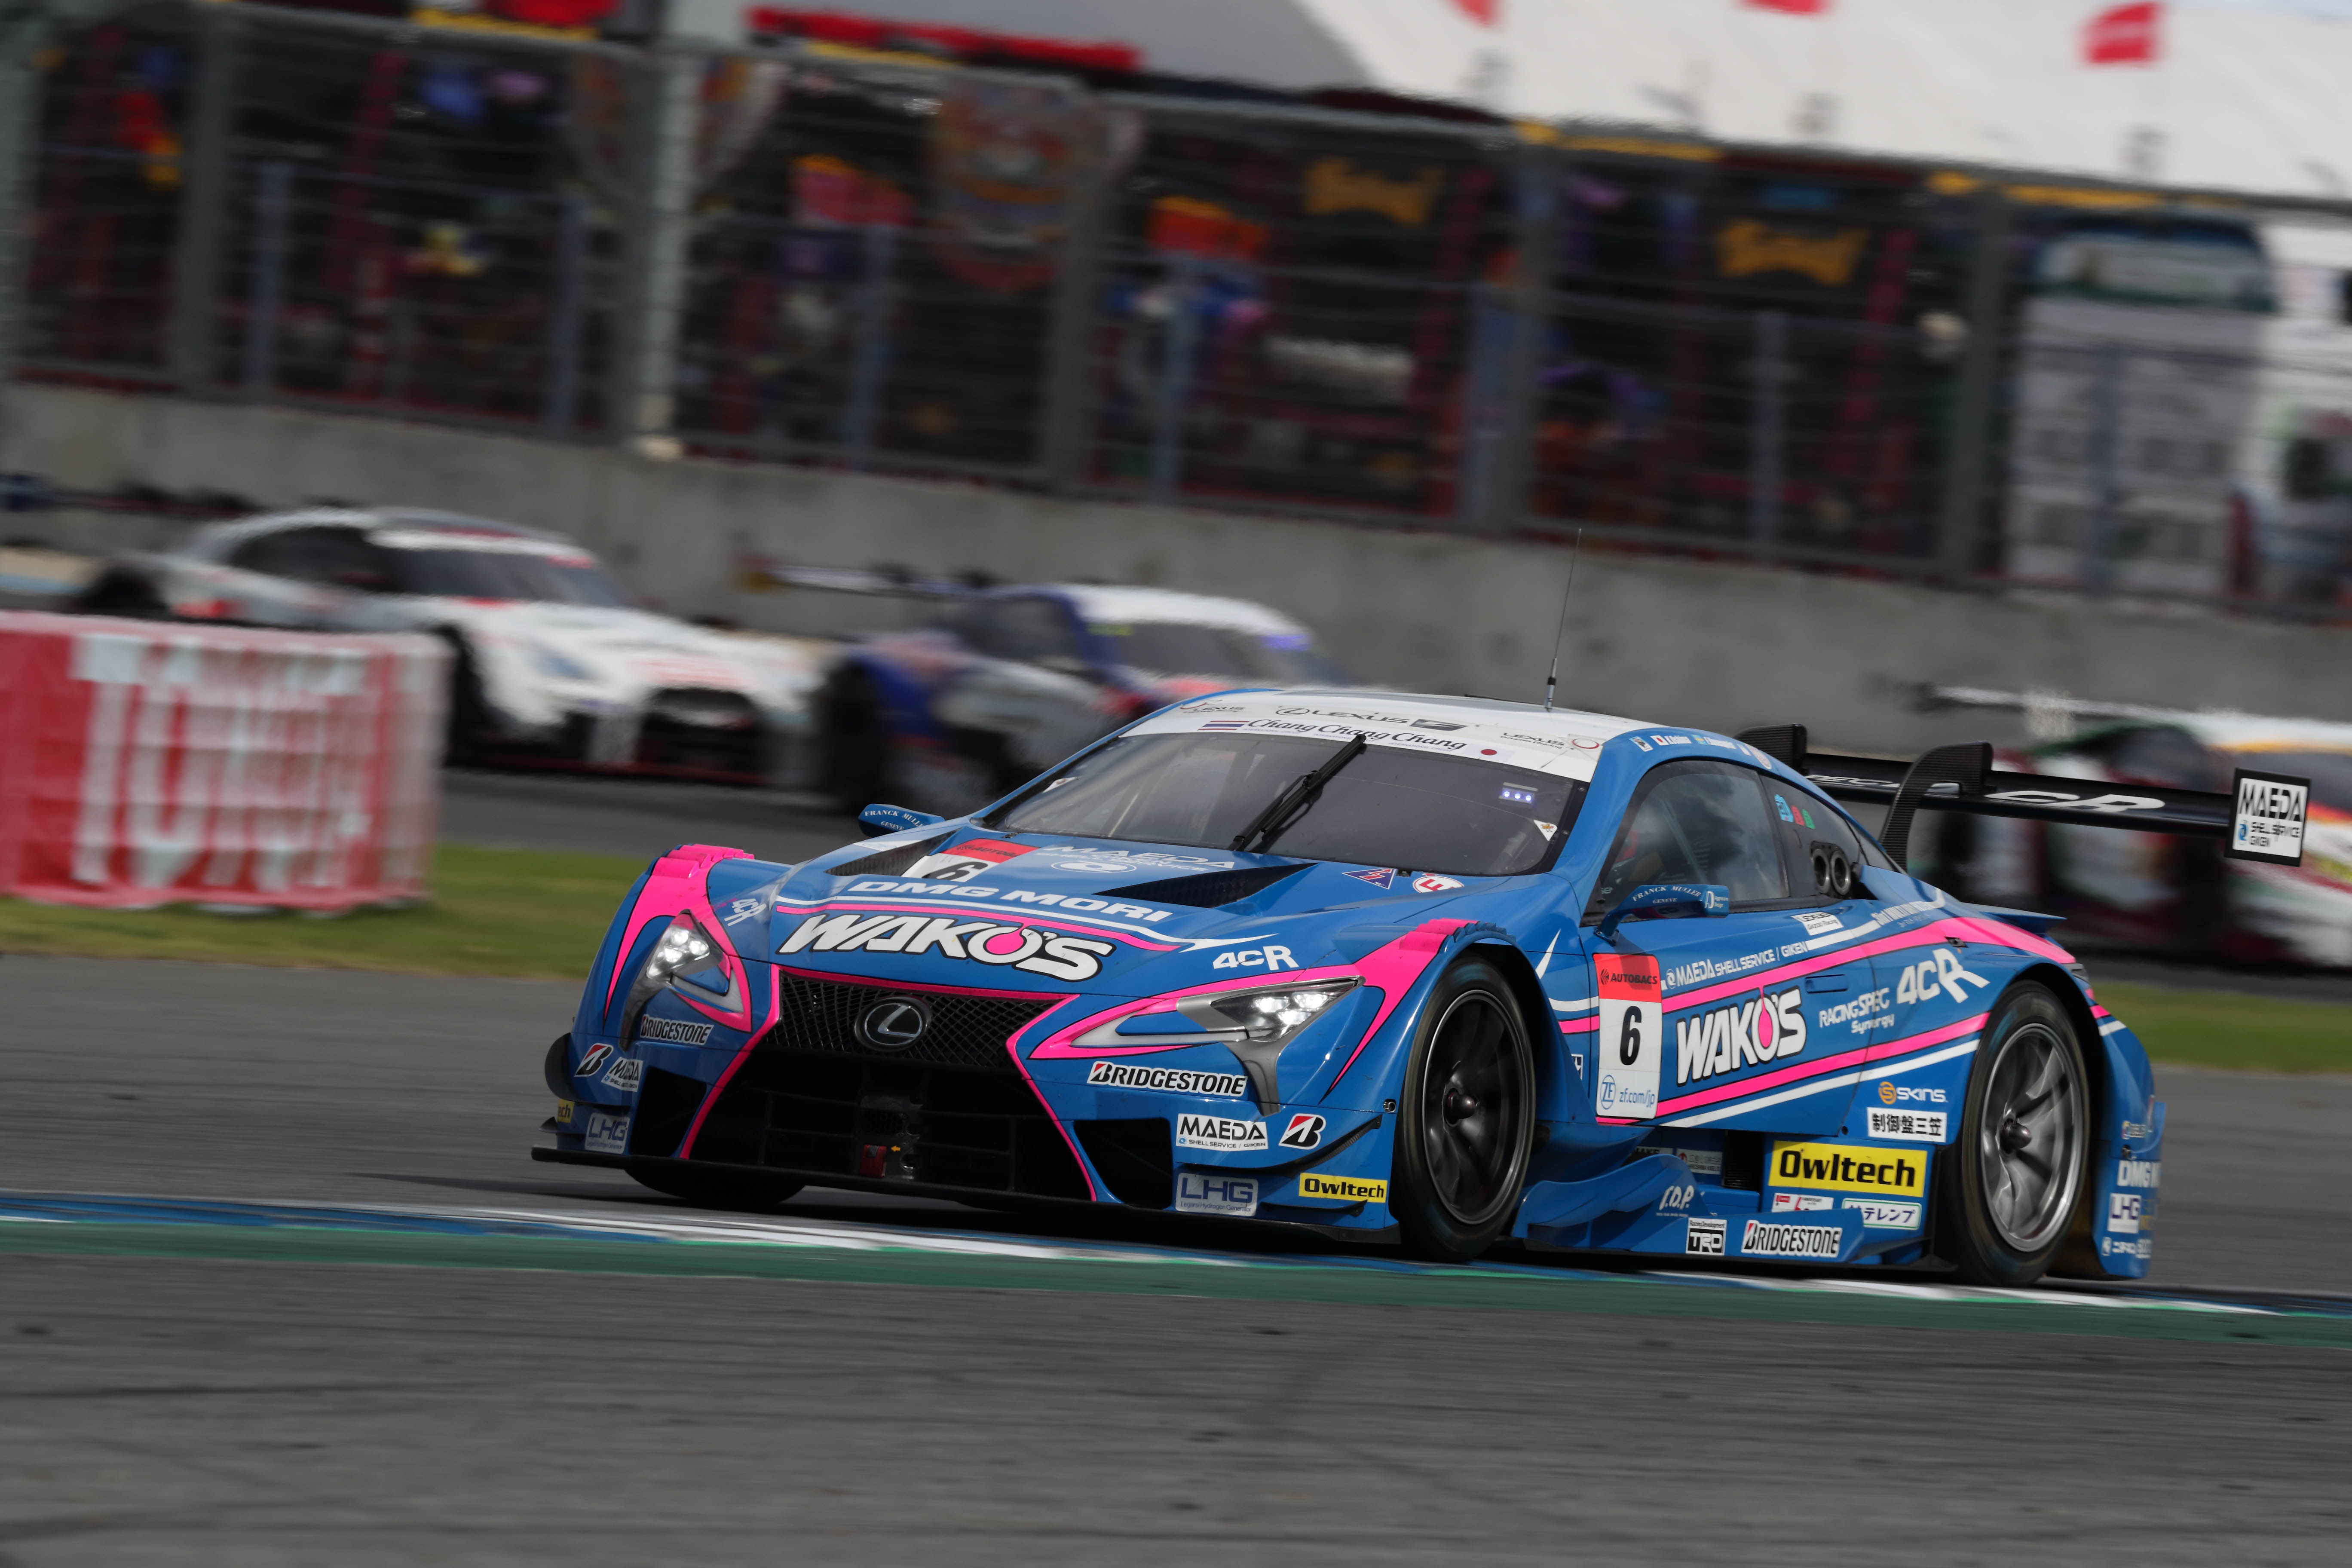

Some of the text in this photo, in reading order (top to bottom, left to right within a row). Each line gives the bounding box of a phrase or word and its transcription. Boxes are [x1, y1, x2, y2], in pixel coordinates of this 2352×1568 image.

[1312, 710, 1410, 723] LEXUS
[1248, 719, 1467, 750] Chang Chang Chang
[1503, 732, 1565, 746] LEXUS
[2237, 783, 2303, 822] MAEDA
[1043, 846, 1235, 869] MAEDA
[922, 861, 988, 880] 6
[848, 881, 1173, 922] DMG MORI
[1632, 886, 1702, 902] FRANCK MULLER
[776, 913, 1116, 982] WAKO'S
[1213, 946, 1299, 971] 4CR
[1676, 959, 1715, 986] MAEDA
[1715, 959, 1740, 976] SHELL
[1739, 949, 1775, 968] SERVICE
[1780, 941, 1807, 957] GIKEN
[1610, 973, 1657, 985] AUTOBACS
[1896, 948, 1991, 1004] 4CR
[641, 1016, 712, 1044] BRIDGESTONE
[1620, 1006, 1642, 1066] 6
[1677, 986, 1806, 1086] WAKO'S
[1850, 1013, 1895, 1035] Synergy
[1092, 1063, 1246, 1096] BRIDGESTONE
[1619, 1089, 1655, 1108] zf.com/jp
[588, 1117, 628, 1141] LHG
[1179, 1116, 1265, 1140] MAEDA
[1872, 1113, 1942, 1136] 制御盤三笠
[1779, 1148, 1915, 1188] Owltech
[1181, 1177, 1253, 1203] LHG
[1304, 1178, 1384, 1199] Owltech
[1226, 1204, 1252, 1212] Generator
[1690, 1231, 1723, 1253] TRD
[1744, 1222, 1841, 1254] BRIDGESTONE
